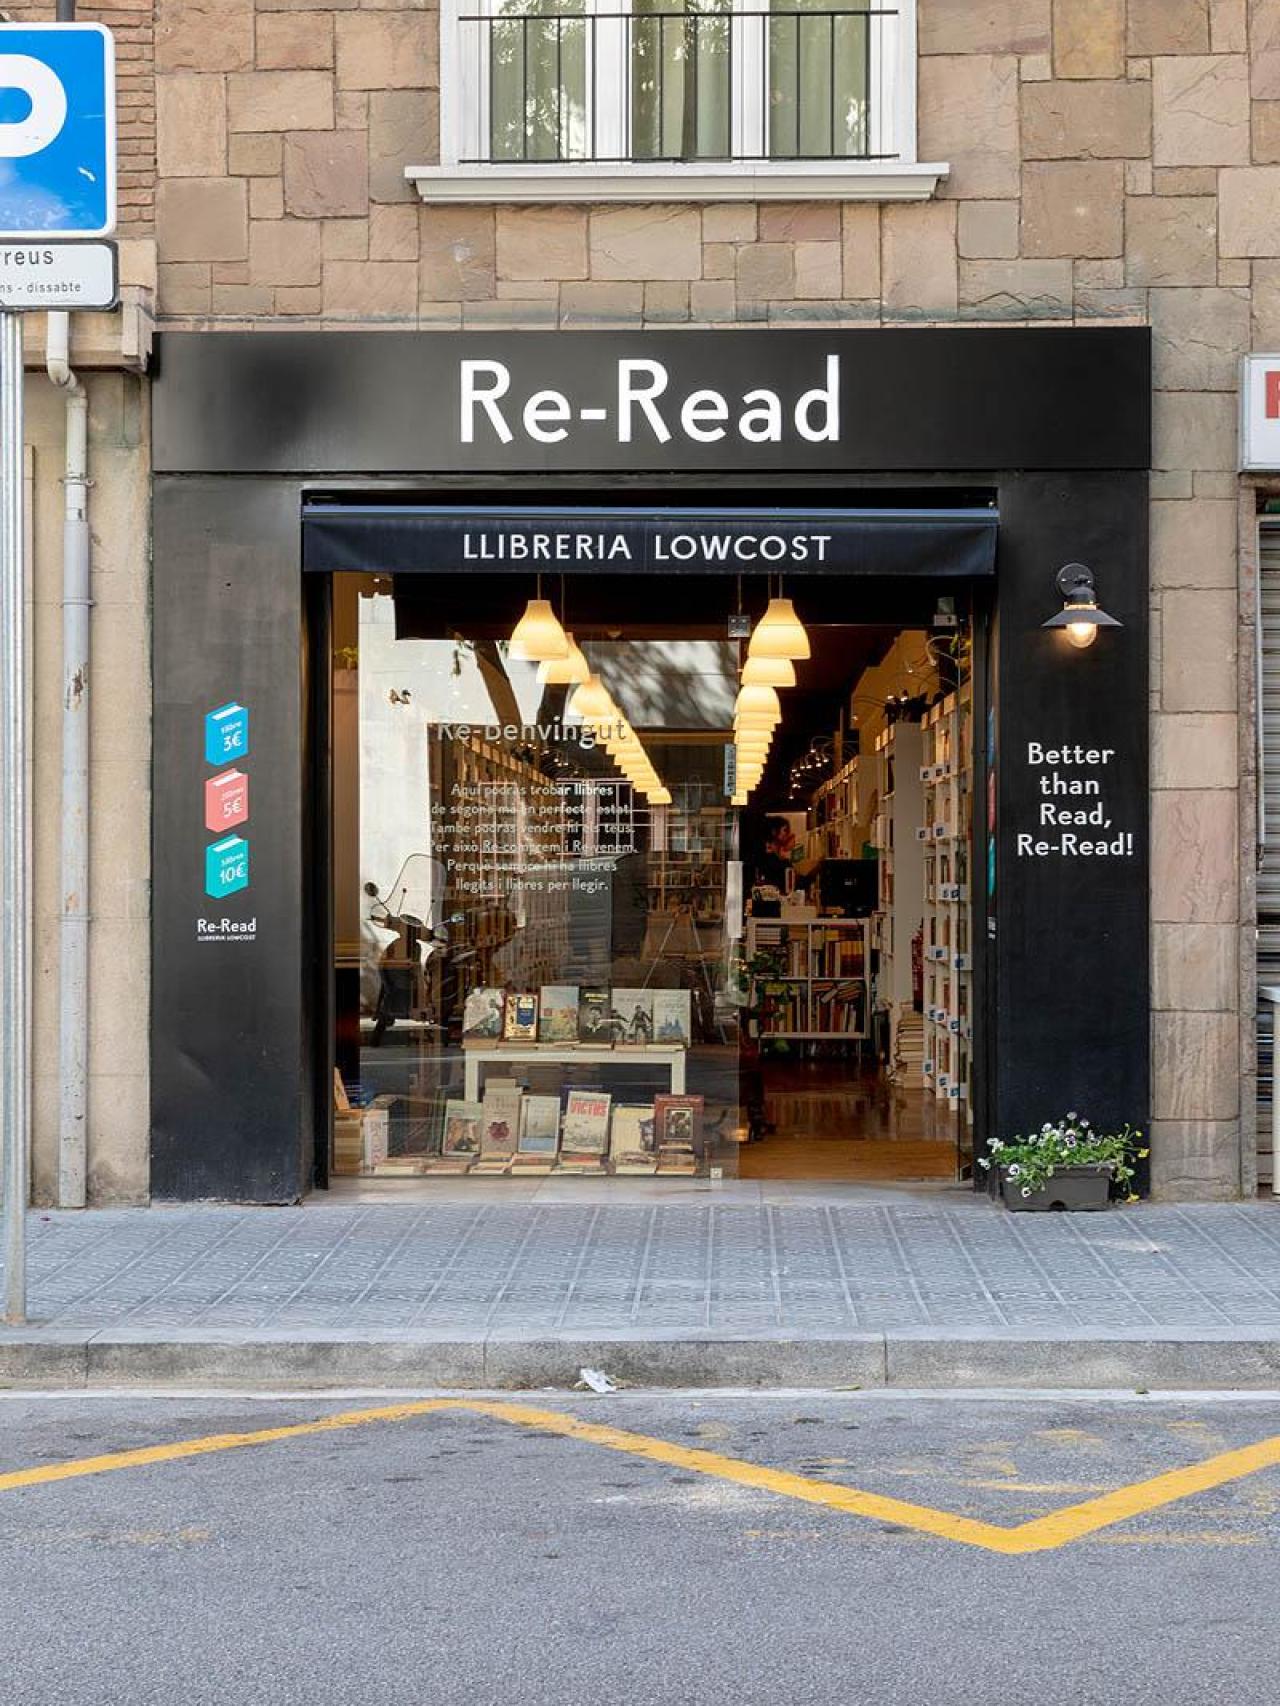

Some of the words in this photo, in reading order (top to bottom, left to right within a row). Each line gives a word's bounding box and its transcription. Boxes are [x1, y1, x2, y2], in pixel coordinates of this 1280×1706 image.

[26, 281, 81, 293] dissabte
[460, 354, 841, 444] Re-Read
[463, 534, 632, 560] LLIBRERIA
[655, 534, 832, 561] LOWCOST
[223, 730, 242, 752] 3€
[1028, 742, 1115, 764] Better
[530, 783, 571, 796] trobar
[573, 783, 613, 796] llibres
[1039, 772, 1099, 795] than
[223, 798, 242, 818] 5€
[431, 802, 446, 814] de
[1040, 801, 1112, 828] Read,
[1017, 832, 1133, 856] Re-Read!
[219, 862, 248, 884] 10€
[548, 881, 569, 893] per
[572, 877, 609, 893] llegir.
[197, 917, 257, 933] Re-Read
